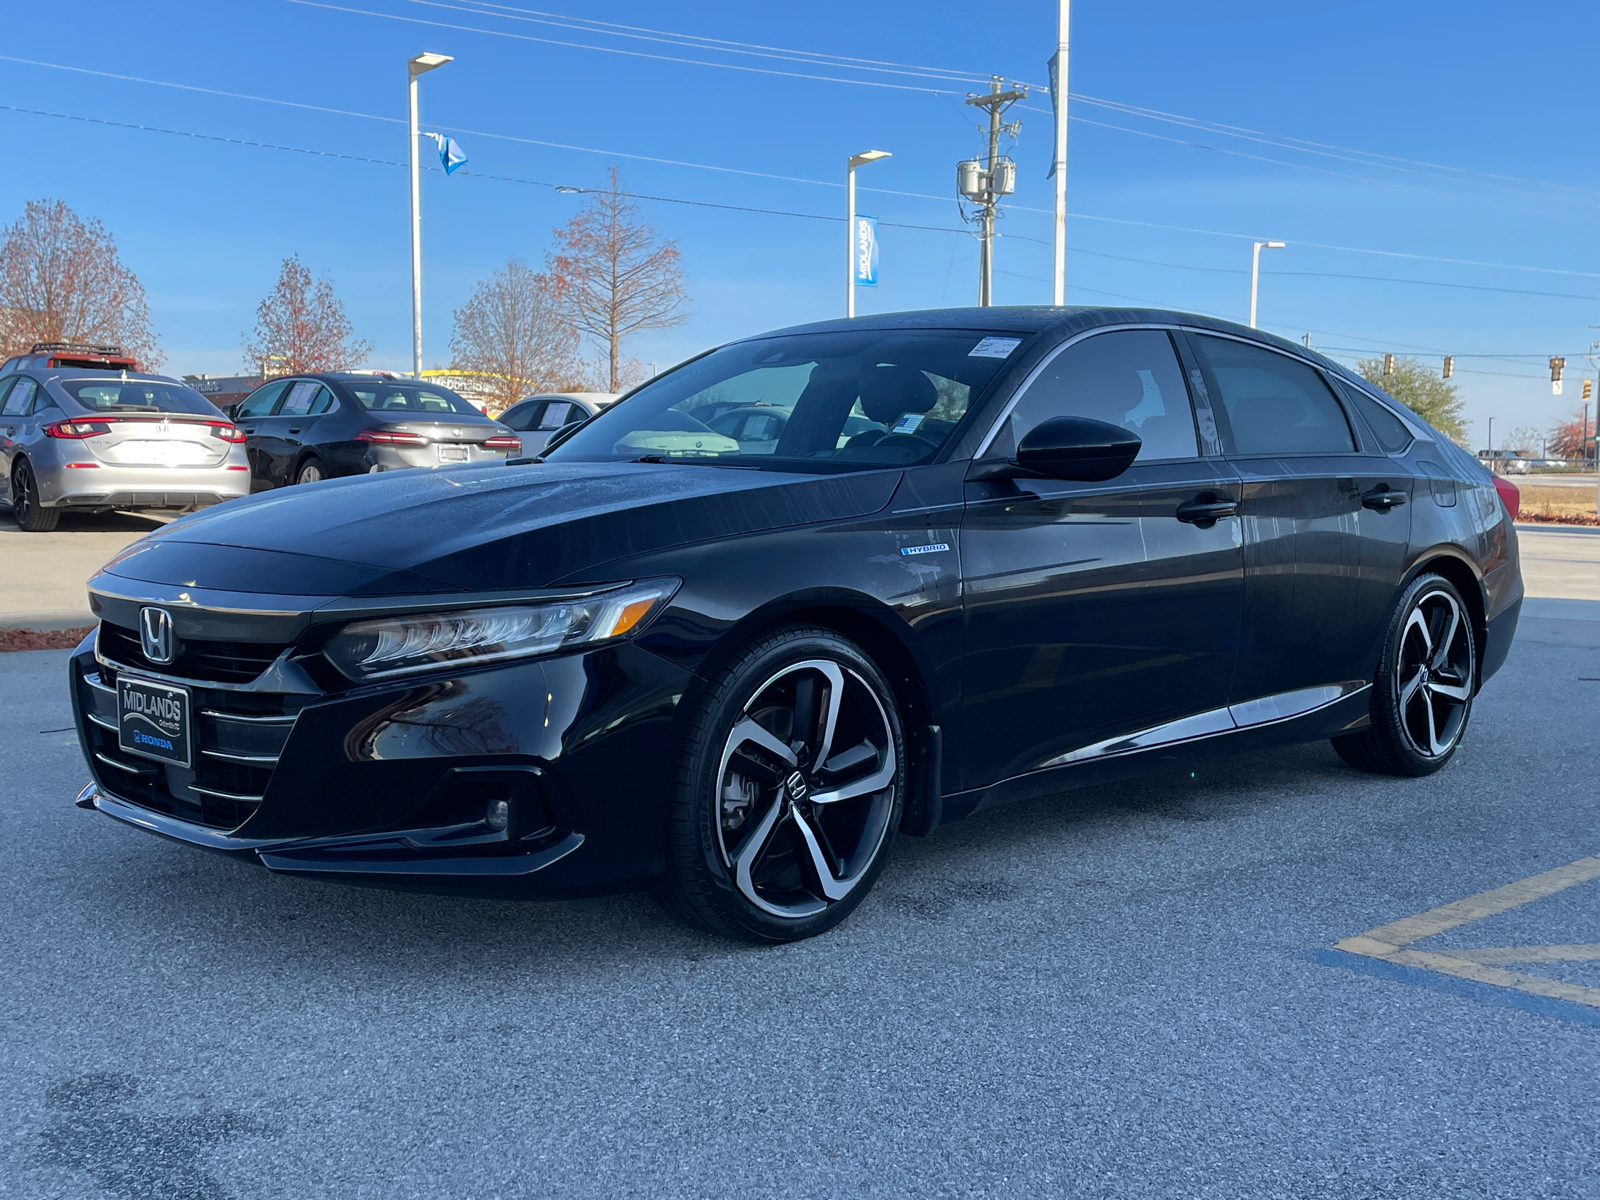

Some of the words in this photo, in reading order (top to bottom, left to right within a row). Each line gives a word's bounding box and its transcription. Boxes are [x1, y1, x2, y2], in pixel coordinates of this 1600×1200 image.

[858, 220, 868, 278] MIDLANDS
[910, 544, 946, 554] HYBRID
[123, 689, 181, 721] MIDLANDS
[141, 734, 174, 750] HONDA
